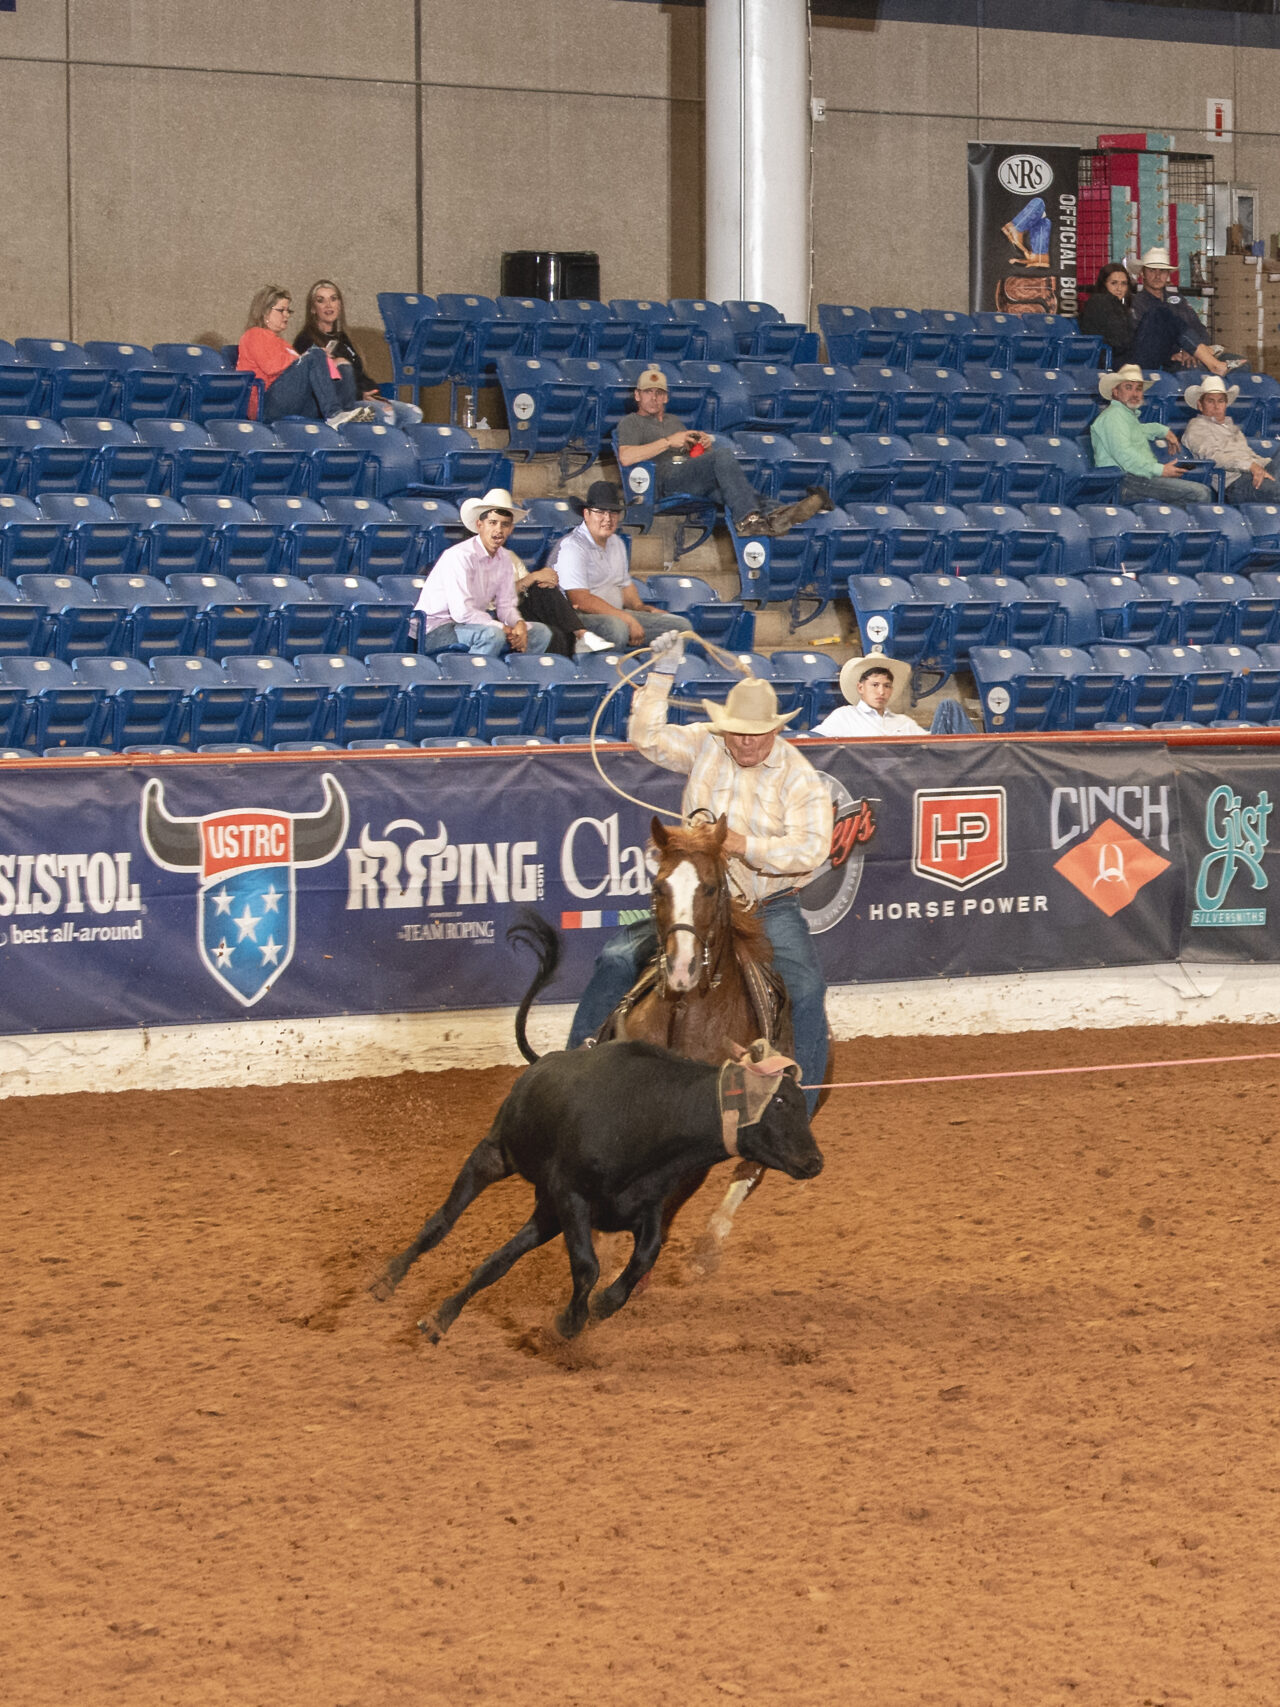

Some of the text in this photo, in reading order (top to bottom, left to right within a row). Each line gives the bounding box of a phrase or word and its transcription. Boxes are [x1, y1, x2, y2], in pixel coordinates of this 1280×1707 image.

[1007, 159, 1044, 189] NRS
[1059, 193, 1077, 270] OFFICIAL
[1051, 785, 1170, 851] CINCH
[207, 822, 286, 860] USTRC
[933, 812, 991, 863] HP
[869, 895, 1049, 921] HORSE POWER
[1193, 911, 1265, 924] SILVERSMITHS
[10, 920, 143, 945] best all-around
